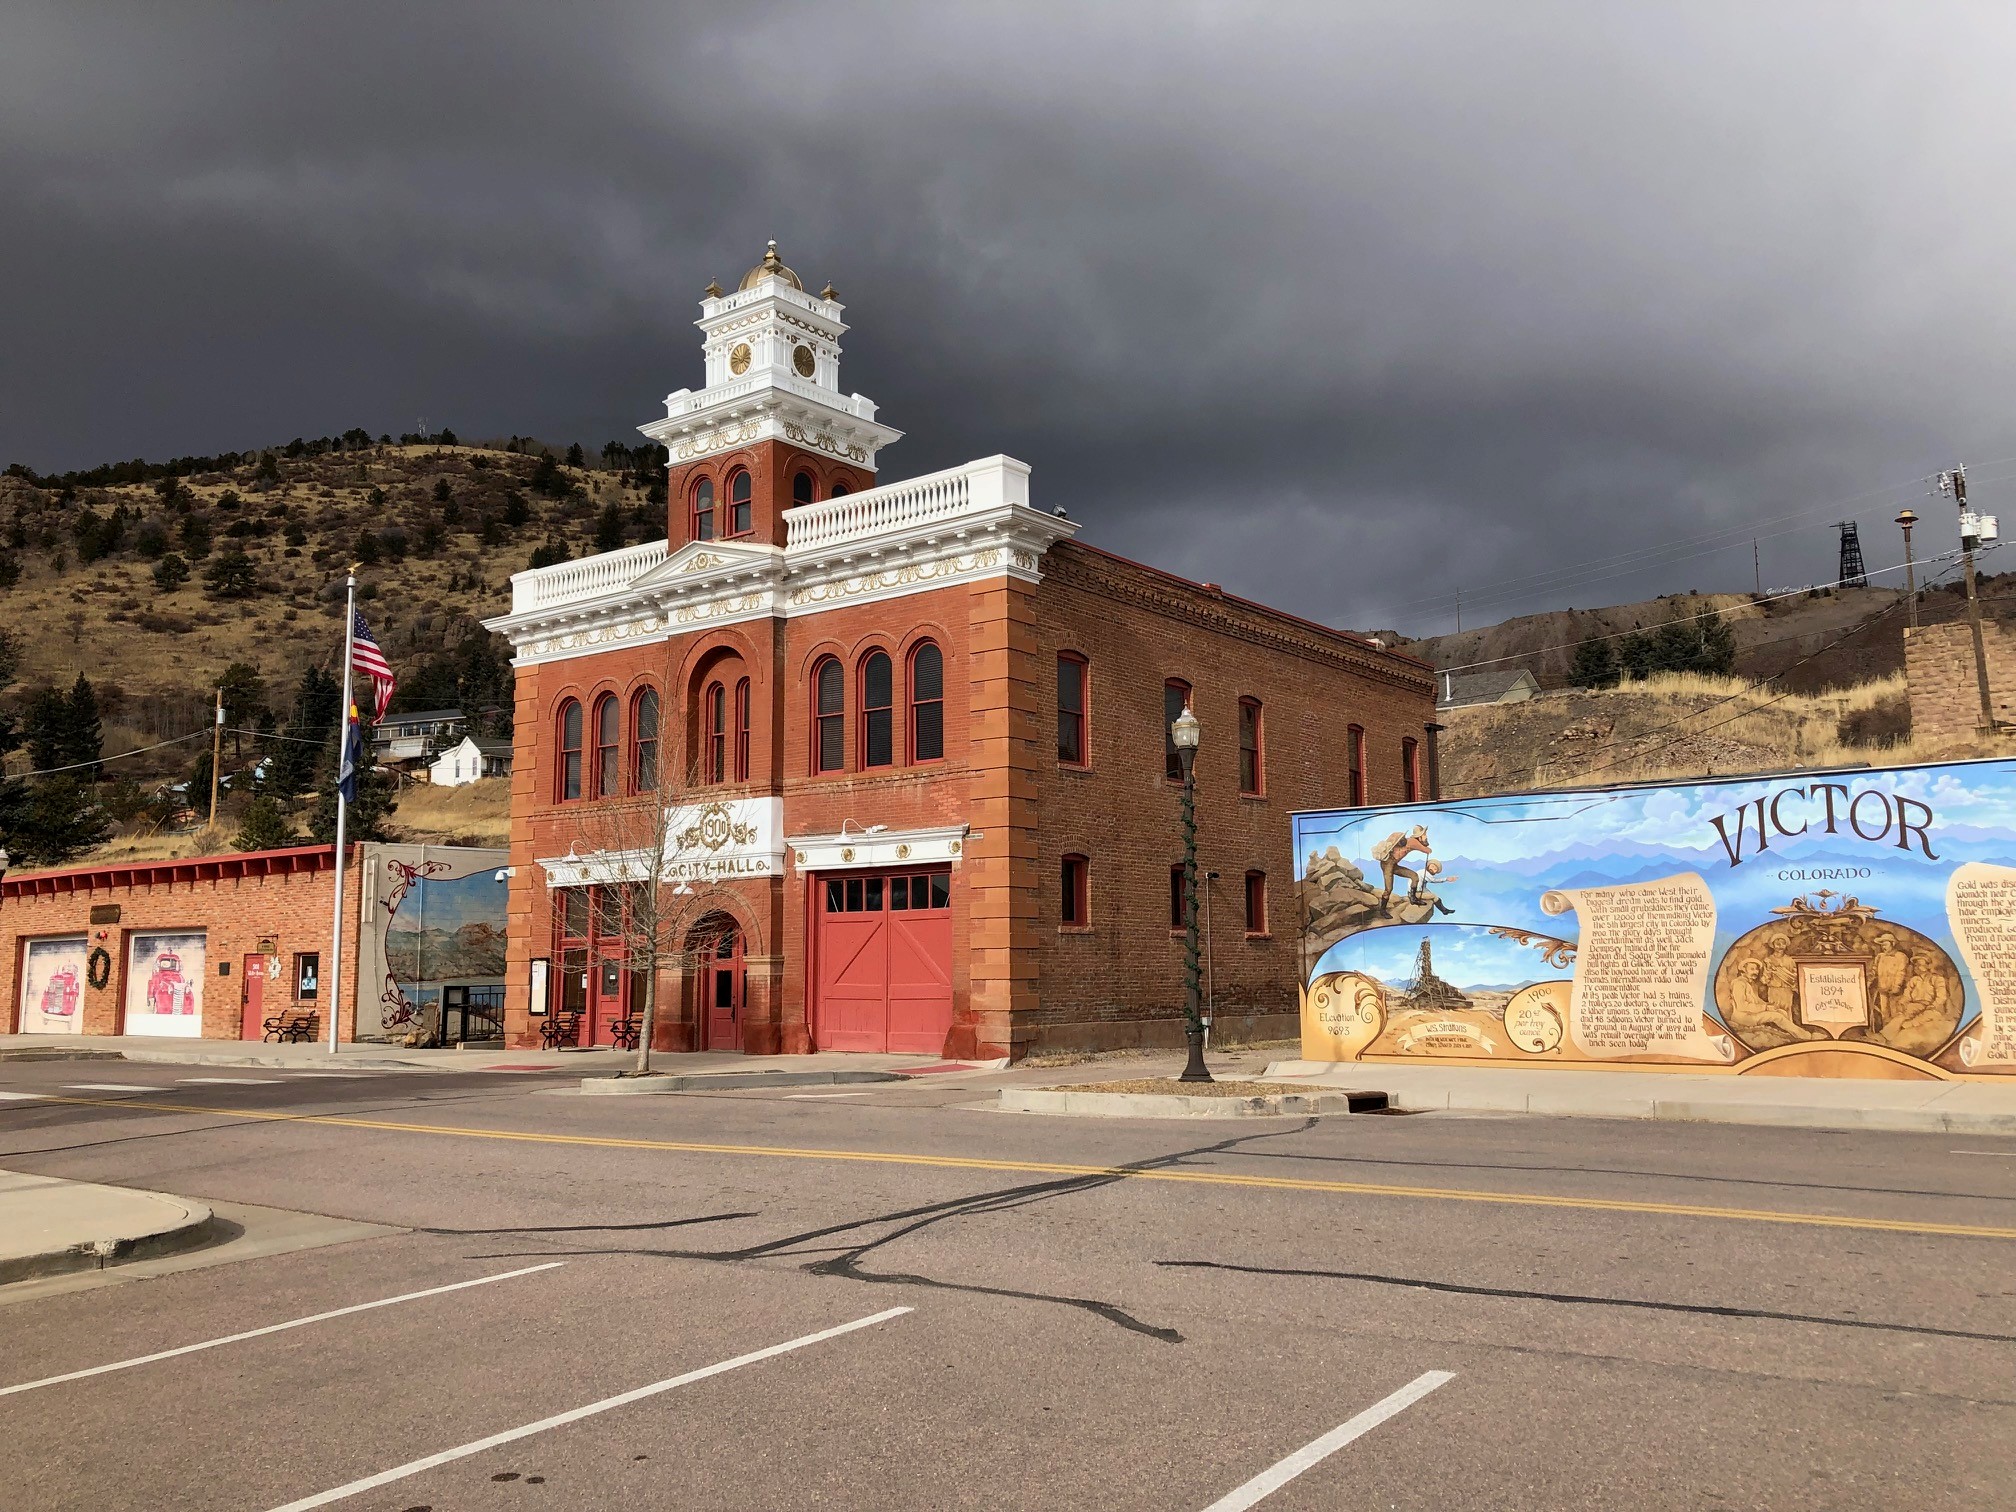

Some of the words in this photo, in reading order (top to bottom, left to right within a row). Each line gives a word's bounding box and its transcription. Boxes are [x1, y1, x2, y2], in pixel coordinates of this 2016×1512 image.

[705, 818, 726, 838] 1900
[1709, 784, 1940, 868] VICTOR
[1778, 867, 1871, 881] COLORADO
[1958, 880, 1977, 890] Gold
[1980, 881, 1998, 890] was
[1596, 891, 1615, 899] many
[1620, 889, 1635, 897] who
[1638, 889, 1657, 897] came
[1658, 887, 1676, 895] West
[1678, 886, 1697, 895] their
[1990, 890, 2008, 898] near
[1586, 898, 1613, 907] biggest
[1617, 897, 1641, 905] dream
[1661, 896, 1668, 904] to
[1670, 895, 1684, 903] find
[1957, 899, 1988, 909] through
[1991, 898, 2004, 907] the
[1610, 904, 1629, 913] small
[1631, 904, 1673, 914] grubstakes
[1675, 903, 1688, 912] they
[1690, 903, 1709, 911] came
[1958, 908, 1978, 916] have
[1592, 914, 1610, 922] over
[1637, 912, 1646, 920] of
[1620, 920, 1644, 929] largest
[1646, 919, 1658, 929] city
[1661, 919, 1668, 927] in
[1669, 919, 1699, 927] Colorado
[1701, 919, 1710, 928] by
[1623, 928, 1641, 938] glory
[1644, 927, 1662, 937] days
[1665, 926, 1692, 937] brought
[1964, 924, 2003, 935] produced
[1591, 936, 1642, 945] entertainment
[1645, 935, 1654, 943] as
[1675, 934, 1694, 943] Jack
[1967, 934, 1988, 943] from
[1990, 934, 1995, 942] a
[1588, 944, 1622, 954] Dempsey
[1624, 944, 1647, 952] trained
[1649, 944, 1655, 952] at
[1657, 943, 1668, 952] the
[1670, 943, 1681, 952] fire
[1971, 942, 2002, 951] located
[1588, 952, 1611, 960] station
[1614, 950, 1626, 960] and
[1630, 951, 1652, 961] Soapy
[1655, 950, 1674, 959] Smith
[1676, 950, 1706, 960] promoted
[1974, 952, 1988, 960] The
[1587, 960, 1598, 968] bull
[1600, 960, 1619, 970] fights
[1622, 959, 1629, 968] at
[1657, 959, 1678, 967] Victor
[1680, 959, 1698, 967] was
[1981, 960, 1996, 969] and
[1999, 960, 2012, 969] the
[1585, 968, 1599, 976] also
[1601, 968, 1610, 976] the
[1611, 967, 1640, 977] boyhood
[1641, 967, 1658, 976] home
[1661, 967, 1668, 975] of
[1671, 967, 1694, 975] Lowell
[1983, 969, 1993, 978] of
[1994, 969, 2007, 978] the
[1610, 975, 1652, 984] international
[1654, 975, 1671, 984] radio
[1675, 975, 1688, 984] and
[1810, 974, 1856, 984] Established
[1584, 984, 1593, 992] TV
[1820, 986, 1844, 996] 1894
[1528, 988, 1552, 1002] 1900
[1582, 992, 1588, 1000] At
[1590, 991, 1600, 1000] its
[1602, 992, 1619, 1001] peak
[1620, 992, 1641, 1000] Victor
[1643, 991, 1657, 1000] had
[1815, 1001, 1827, 1011] City
[1834, 999, 1854, 1012] Victor
[1588, 1007, 1605, 1015] labor
[1641, 1007, 1677, 1018] attorneys
[1580, 1015, 1593, 1023] and
[1634, 1015, 1655, 1023] Victor
[1657, 1015, 1682, 1024] burned
[1685, 1015, 1692, 1023] to
[1994, 1014, 2004, 1023] In
[1514, 1020, 1529, 1029] per
[1530, 1019, 1545, 1030] troy
[1581, 1022, 1591, 1030] the
[1594, 1023, 1617, 1033] ground
[1620, 1023, 1627, 1031] in
[1629, 1024, 1652, 1033] August
[1656, 1023, 1663, 1031] of
[1683, 1024, 1696, 1032] and
[1995, 1024, 2004, 1035] by
[1328, 1026, 1350, 1036] 9693
[1601, 1032, 1621, 1040] rebuilt
[1658, 1032, 1673, 1040] with
[1675, 1032, 1687, 1040] the
[1993, 1034, 2013, 1042] mine
[1589, 1039, 1606, 1048] brick
[1608, 1040, 1626, 1048] seen
[1991, 1041, 2002, 1051] of
[1987, 1050, 2009, 1060] Gold
